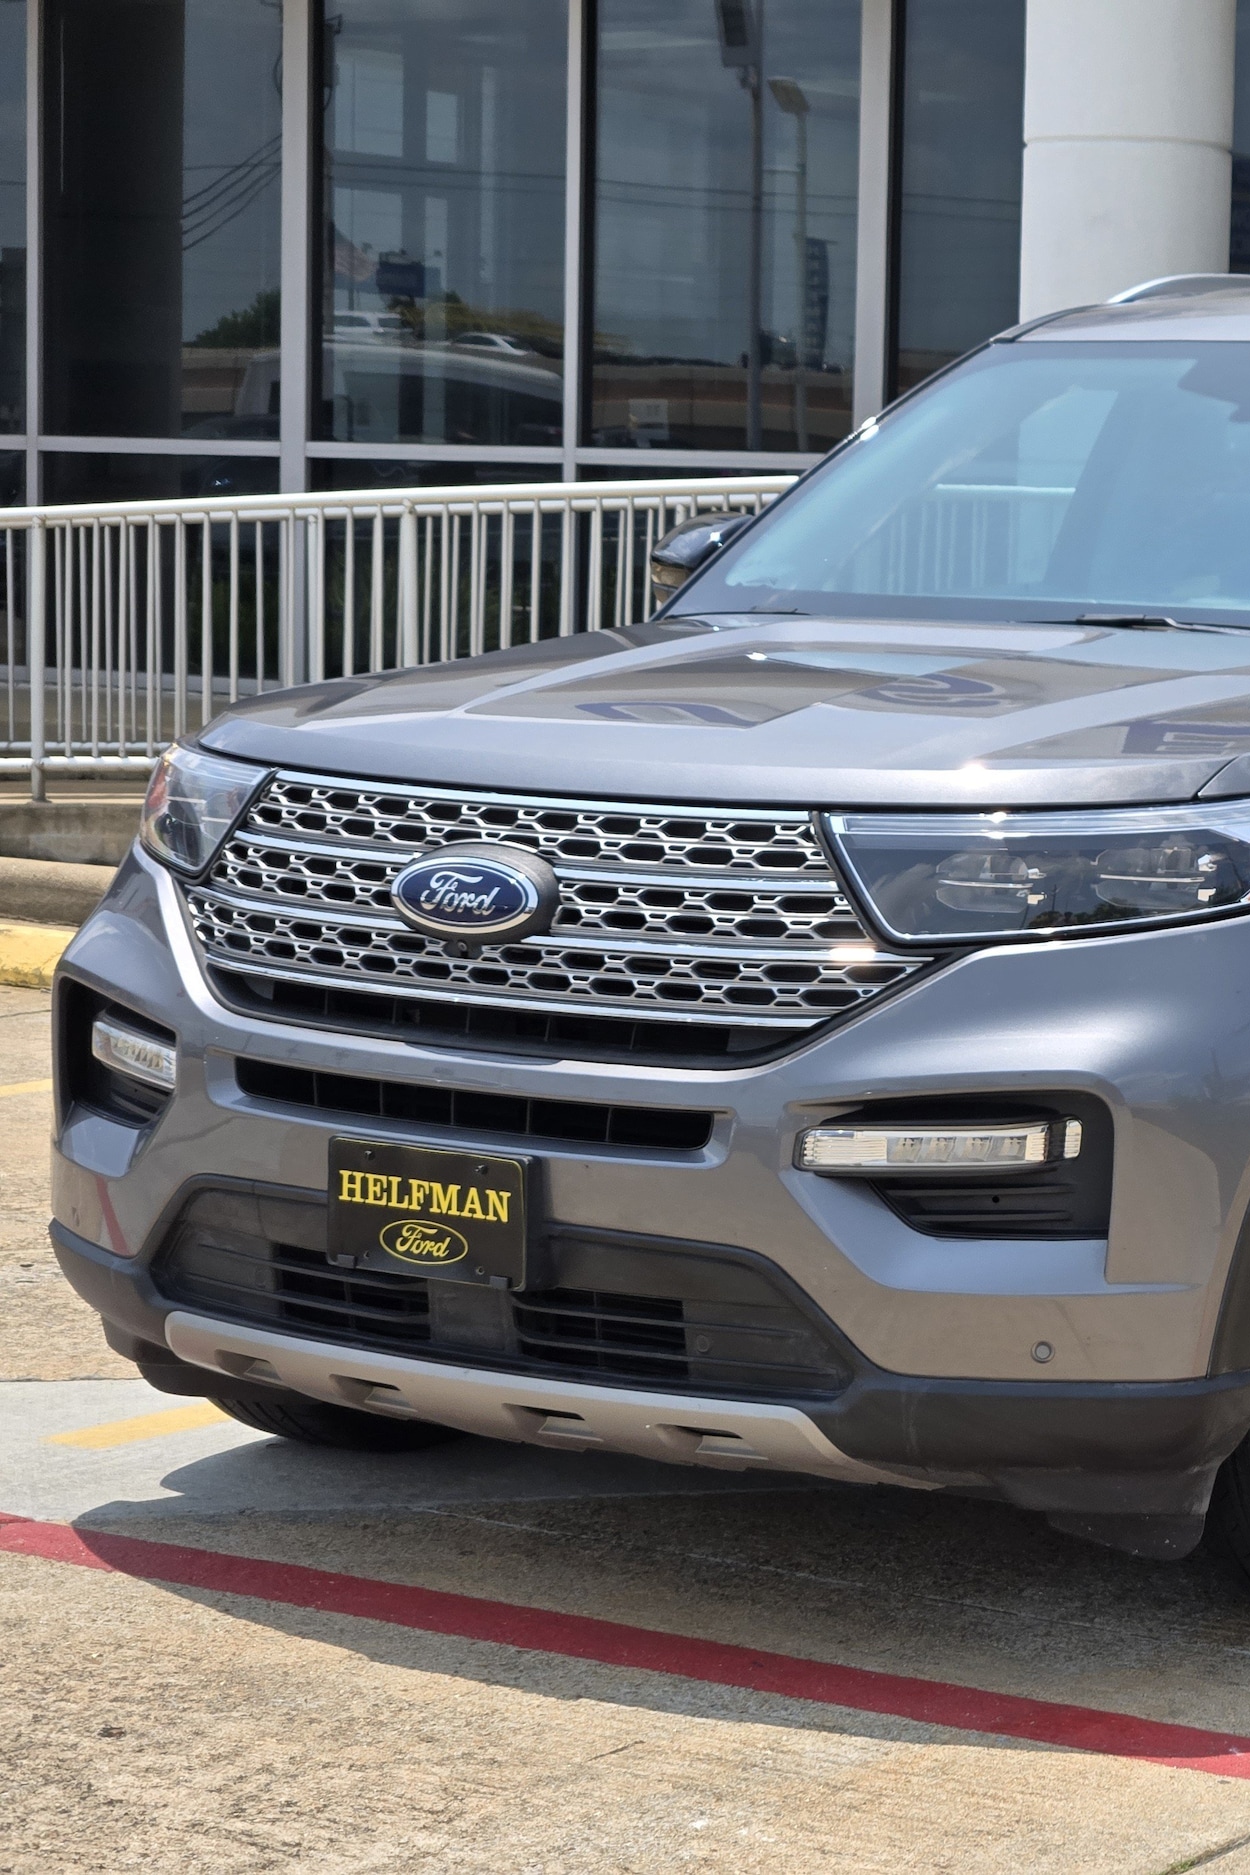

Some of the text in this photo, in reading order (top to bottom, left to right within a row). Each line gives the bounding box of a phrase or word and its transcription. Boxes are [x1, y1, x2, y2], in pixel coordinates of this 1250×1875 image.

[420, 871, 501, 917] Ford
[338, 1169, 512, 1223] HELFMAN
[395, 1223, 451, 1257] Ford
